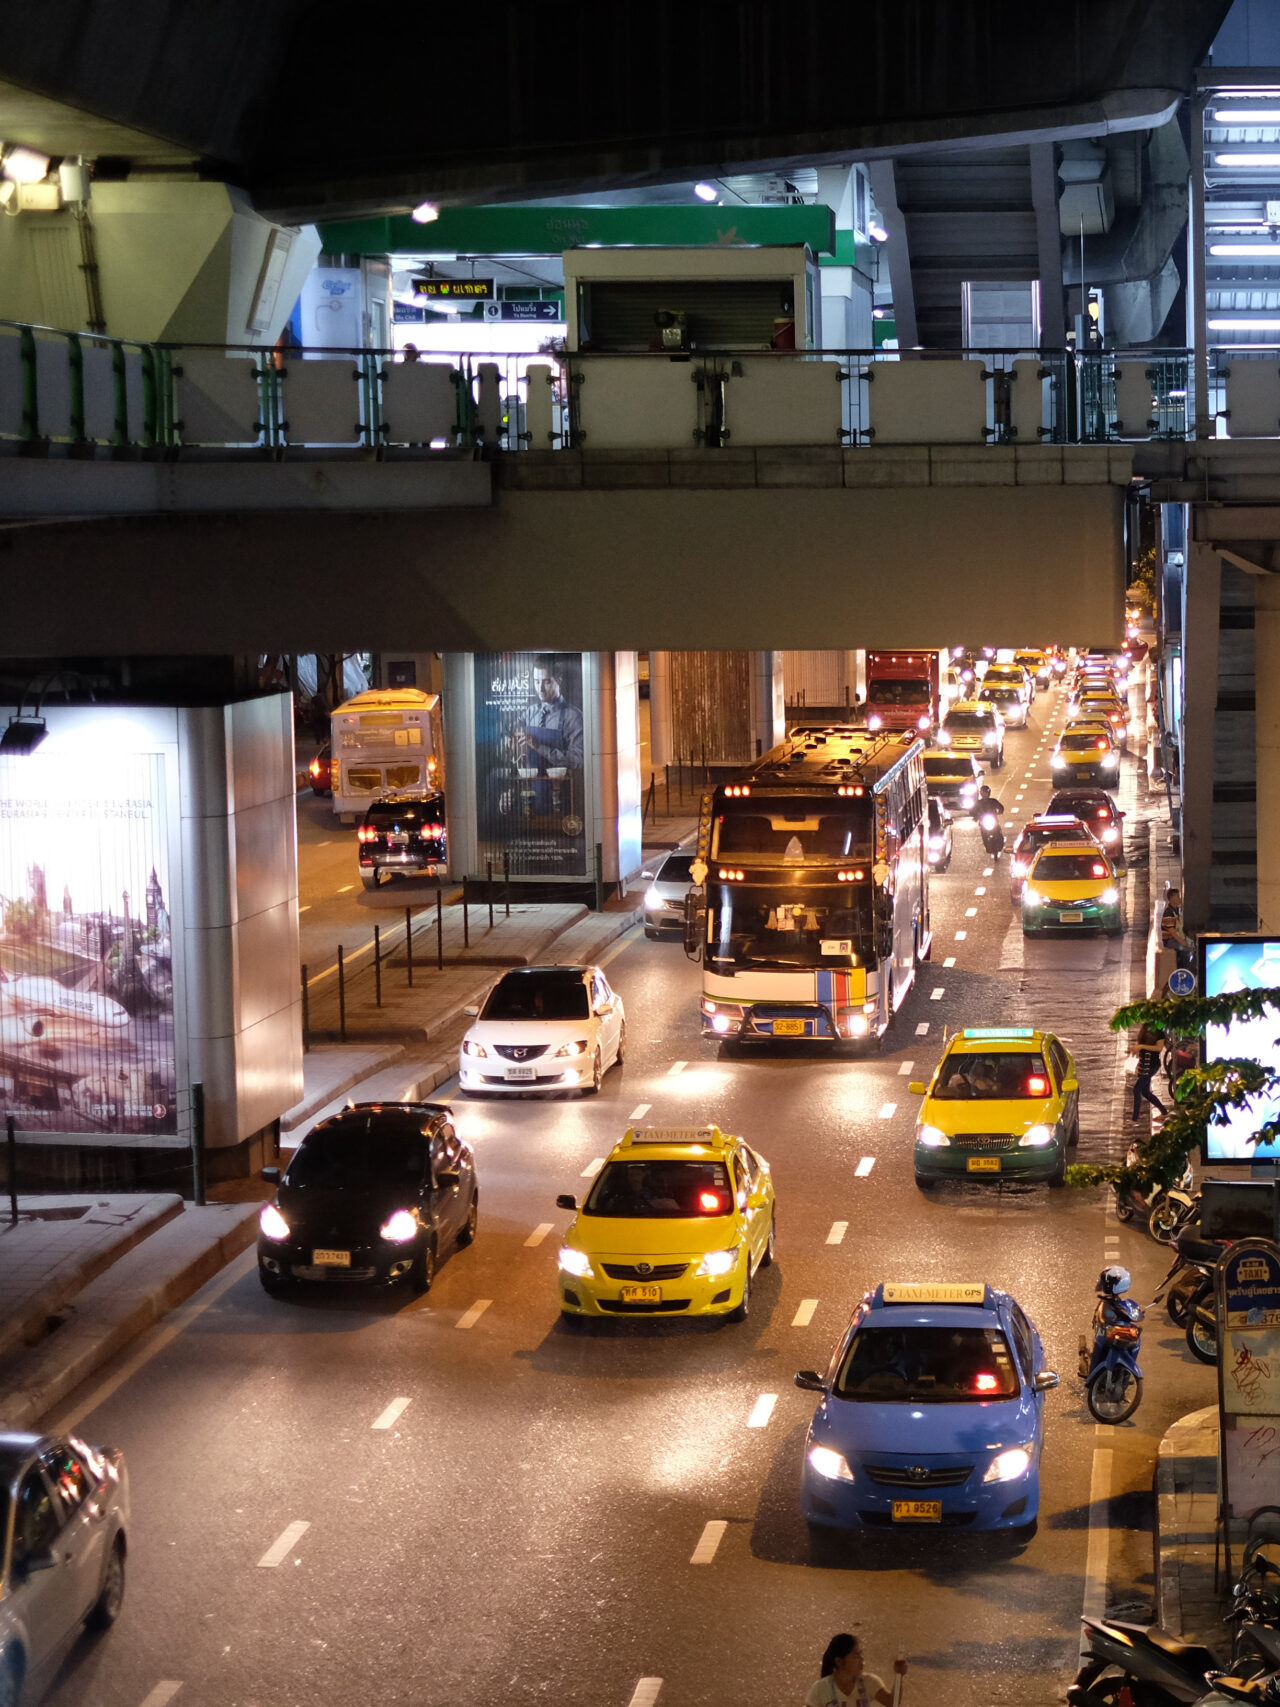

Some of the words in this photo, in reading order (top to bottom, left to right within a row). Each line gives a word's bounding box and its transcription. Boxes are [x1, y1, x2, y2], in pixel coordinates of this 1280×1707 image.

[0, 799, 12, 808] HE
[1243, 1269, 1263, 1278] TAXI
[642, 1288, 657, 1297] 510
[898, 1288, 963, 1299] TAXI-METER
[964, 1289, 982, 1297] GPS
[913, 1503, 938, 1514] 9526
